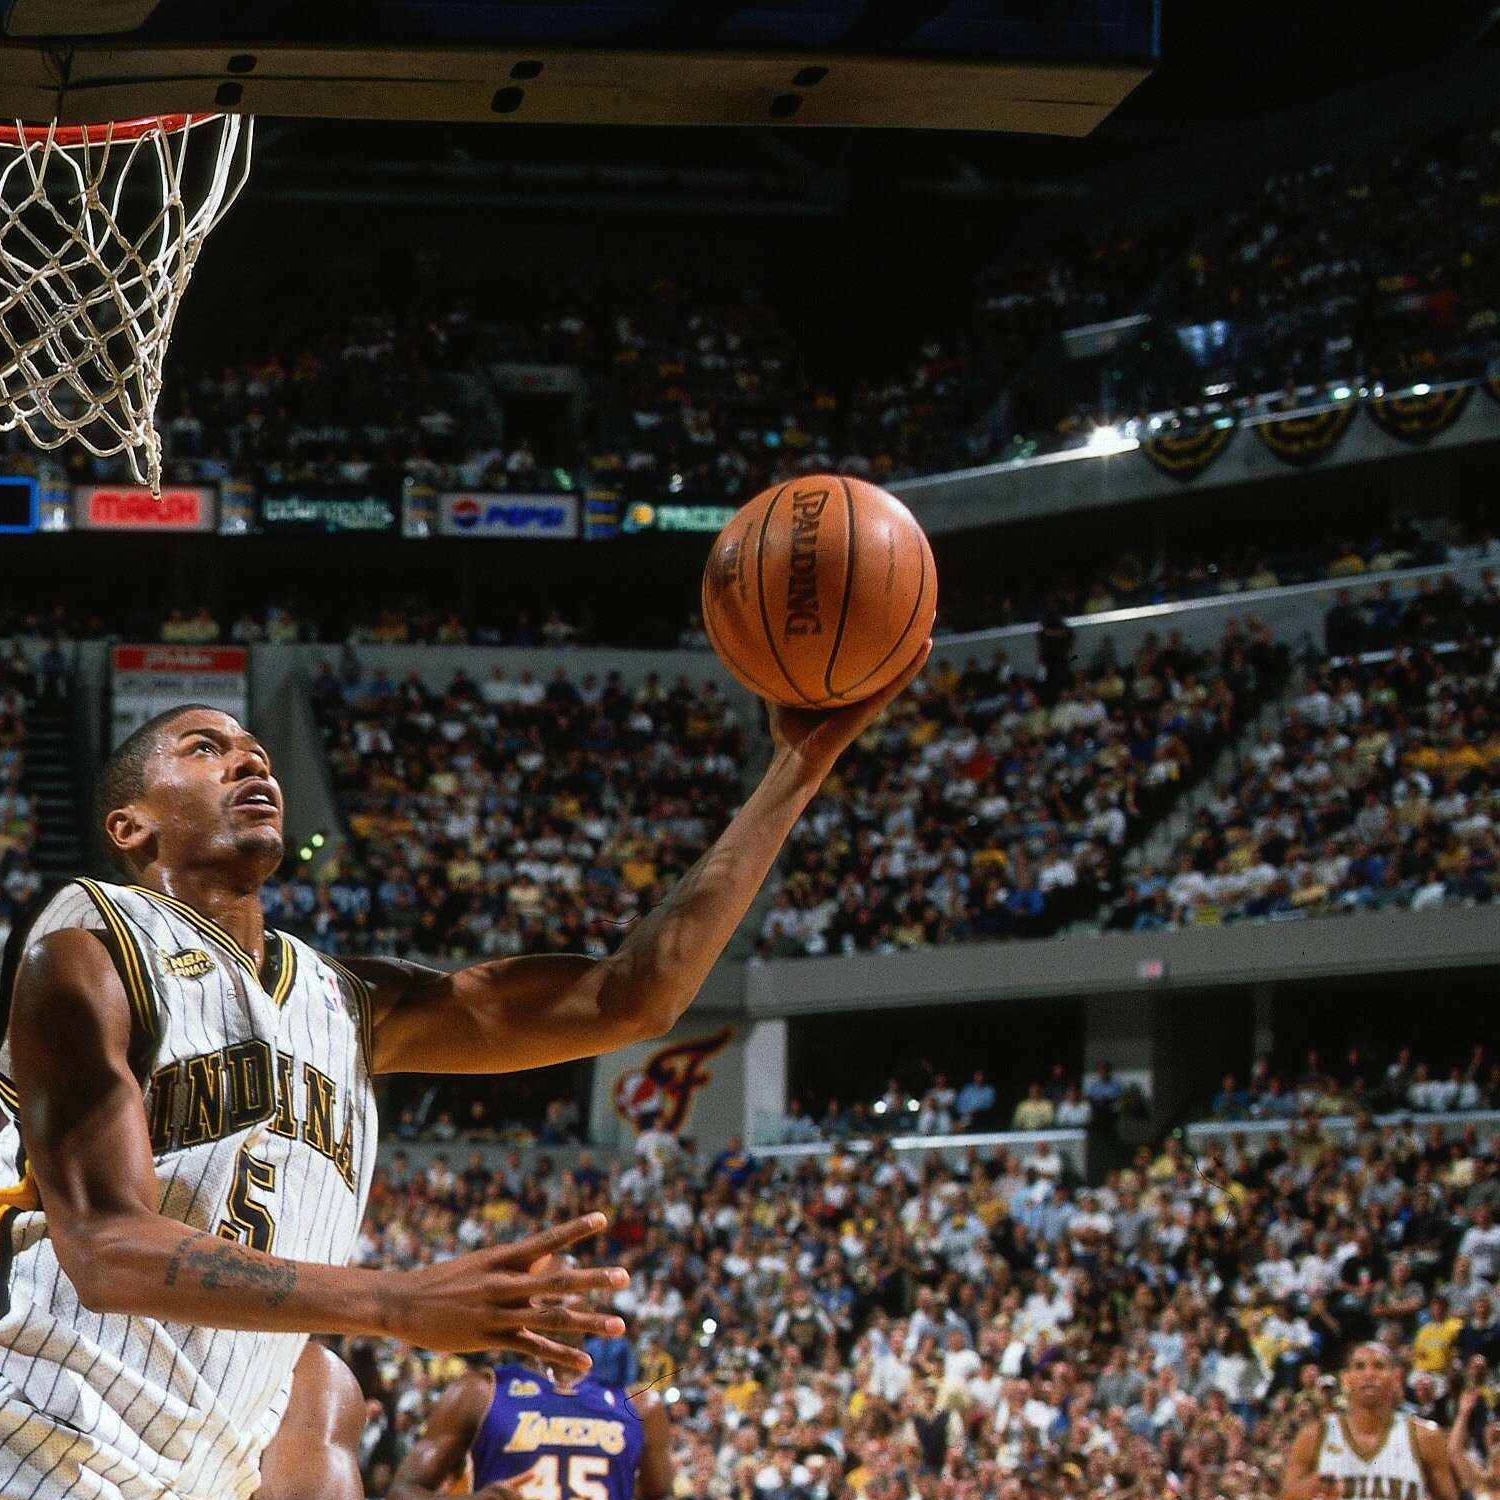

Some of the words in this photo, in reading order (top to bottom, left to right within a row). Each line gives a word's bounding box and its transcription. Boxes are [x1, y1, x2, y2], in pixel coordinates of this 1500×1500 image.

[484, 504, 567, 529] PEPSI
[784, 490, 830, 644] SPALDING
[169, 951, 208, 969] NBA
[216, 1147, 277, 1255] 5
[504, 1411, 626, 1455] LAKERS
